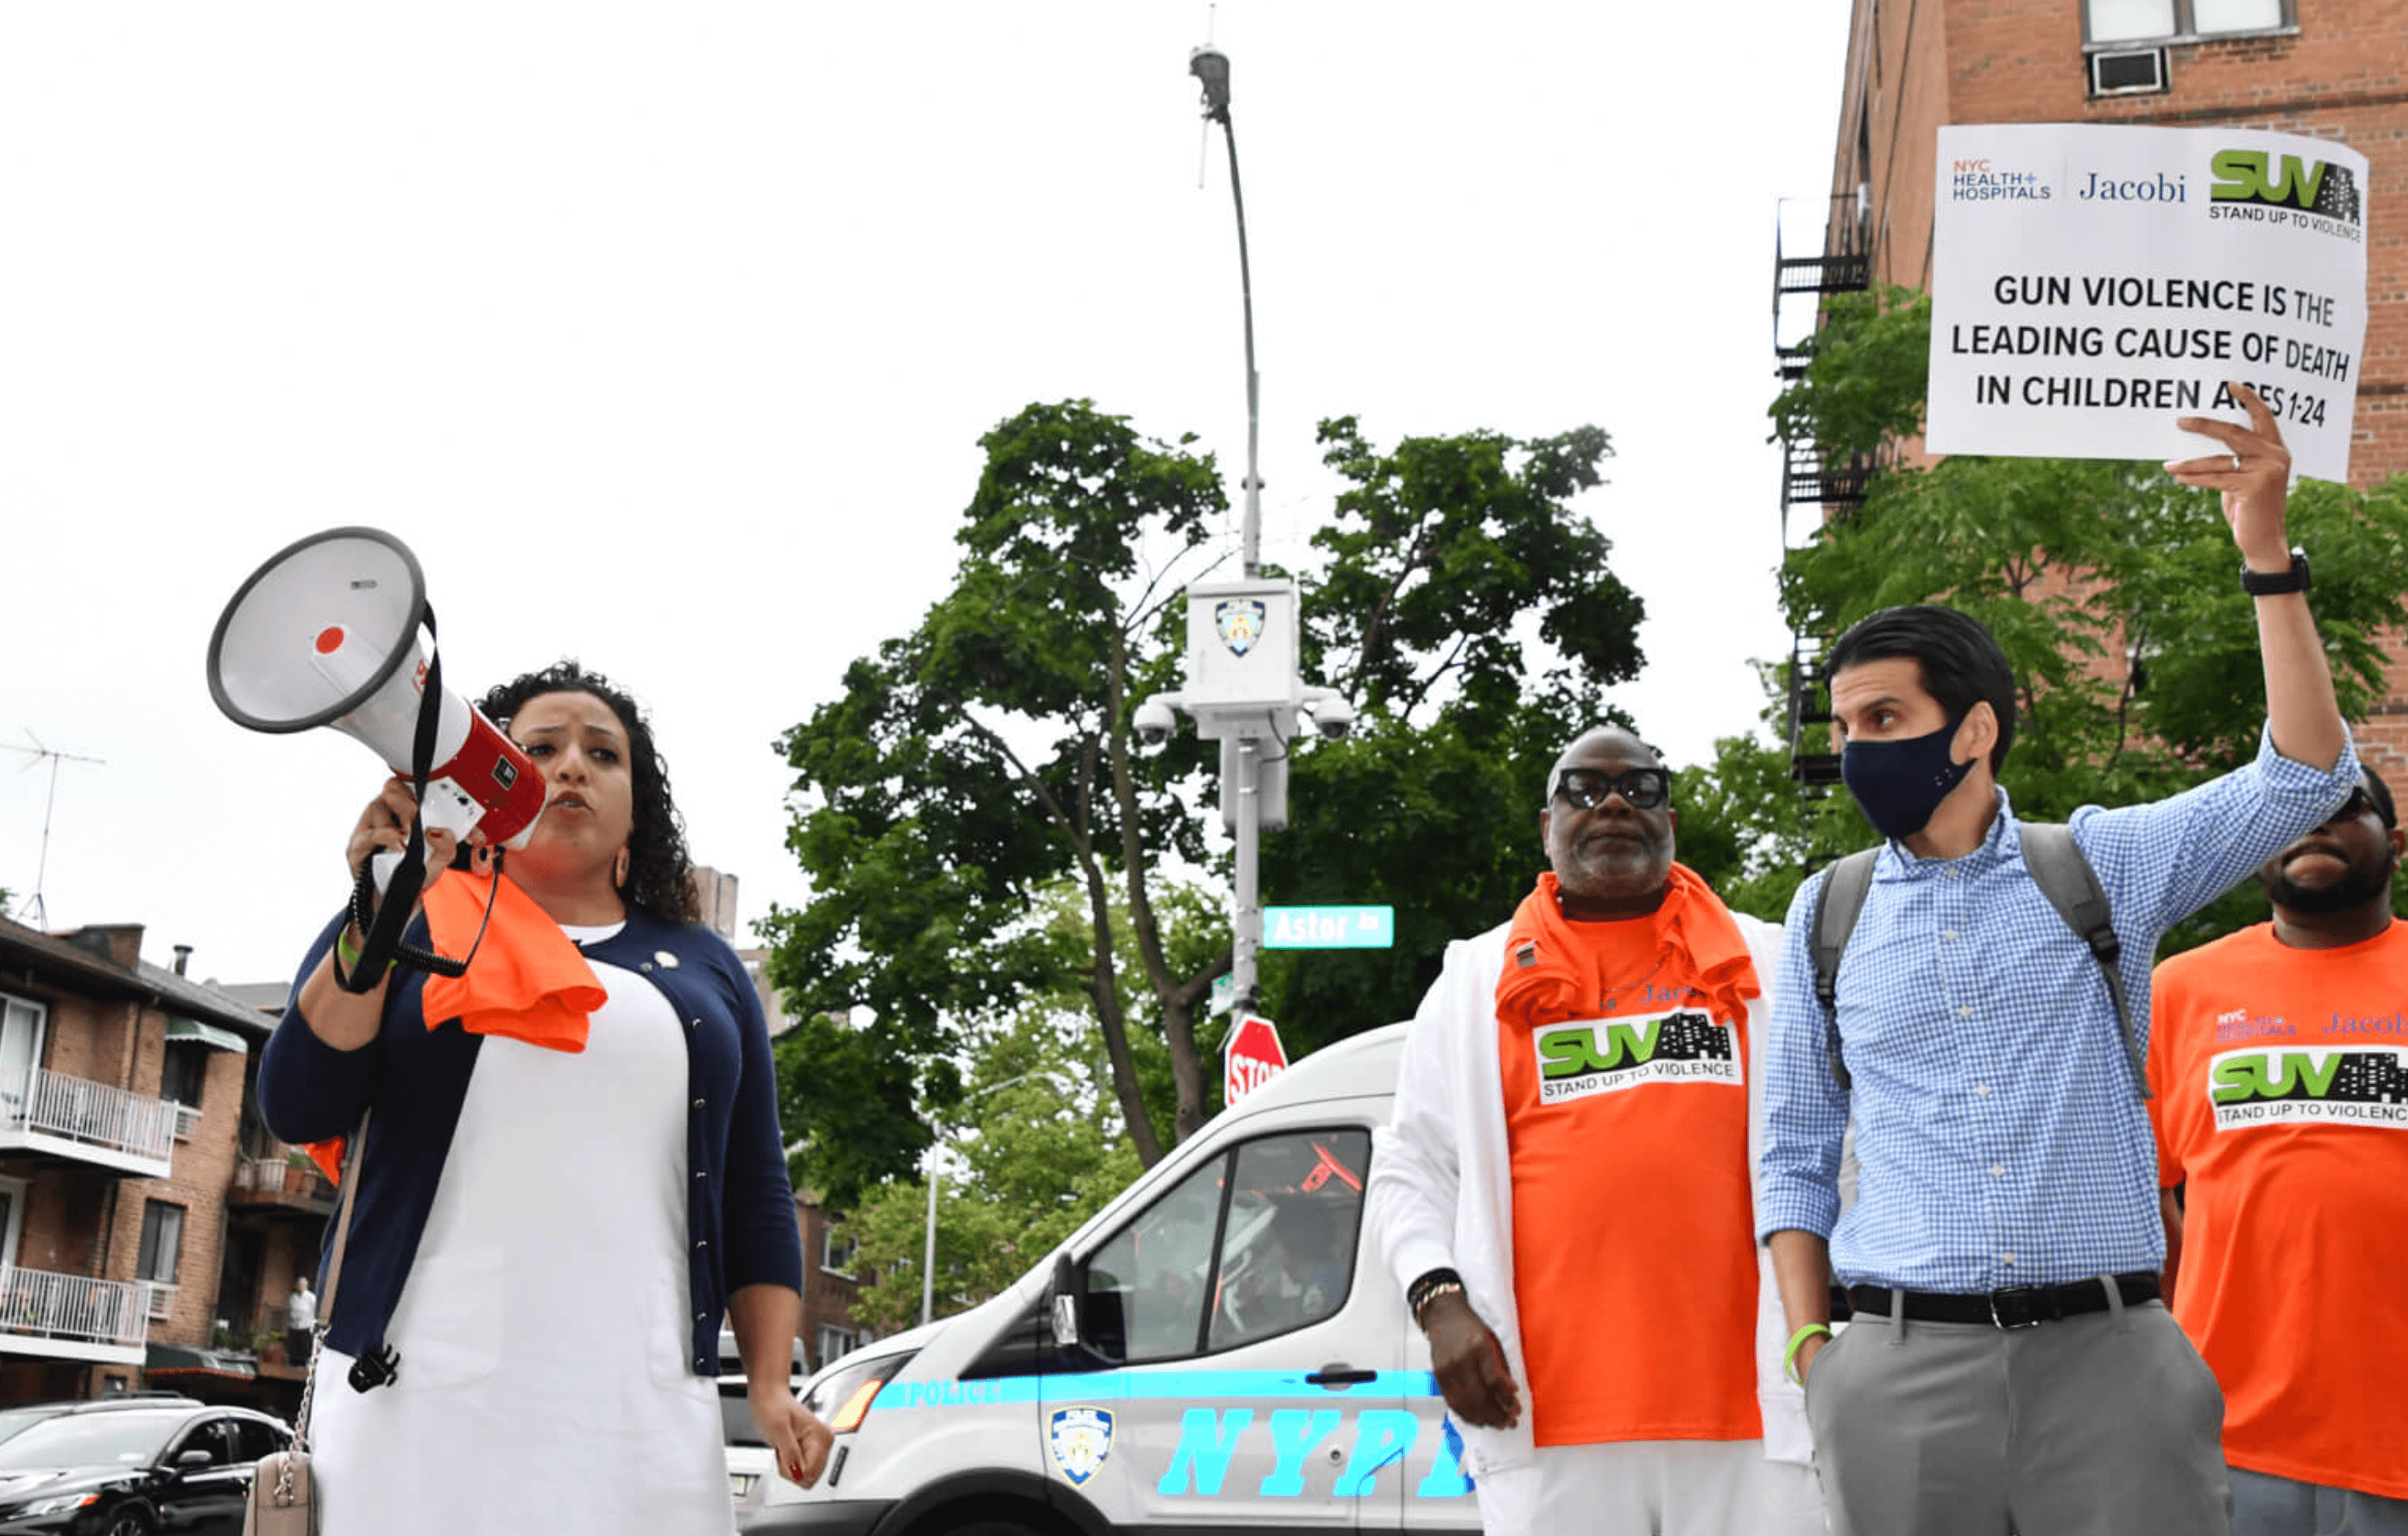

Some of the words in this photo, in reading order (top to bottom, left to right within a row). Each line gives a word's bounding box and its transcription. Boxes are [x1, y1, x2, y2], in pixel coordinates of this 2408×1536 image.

[1954, 159, 1991, 172] NYC
[2210, 149, 2326, 209] SUV
[1953, 185, 2052, 201] HOSPITALS
[2080, 172, 2186, 203] Jacobi
[2210, 206, 2265, 222] STAND
[2269, 209, 2288, 224] UP
[2292, 213, 2309, 230] TO
[2310, 217, 2361, 243] VIOLENCE
[1994, 275, 2071, 306] GUN
[2081, 276, 2254, 312] VIOLENCE
[2263, 284, 2287, 316] IS
[2293, 289, 2335, 327] THE
[1951, 323, 2104, 357] LEADING
[2115, 327, 2231, 360] CAUSE
[2241, 331, 2280, 365] OF
[2285, 338, 2350, 383] DEATH
[1976, 374, 2011, 405] IN
[2022, 376, 2201, 410] CHILDREN
[1274, 911, 1350, 942] Astor
[2321, 1012, 2408, 1036] Jacob
[1539, 1021, 1661, 1078] SUV
[1230, 1053, 1284, 1106] STO
[1542, 1077, 1598, 1098] STAND
[1602, 1073, 1626, 1088] UP
[1629, 1067, 1650, 1084] TO
[1652, 1062, 1735, 1078] VIOLENCE
[2213, 1053, 2343, 1102] SUV
[2269, 1105, 2292, 1118] UP
[2298, 1105, 2322, 1116] TO
[2326, 1105, 2408, 1122] VIOLENC
[906, 1379, 1002, 1408] POLICE
